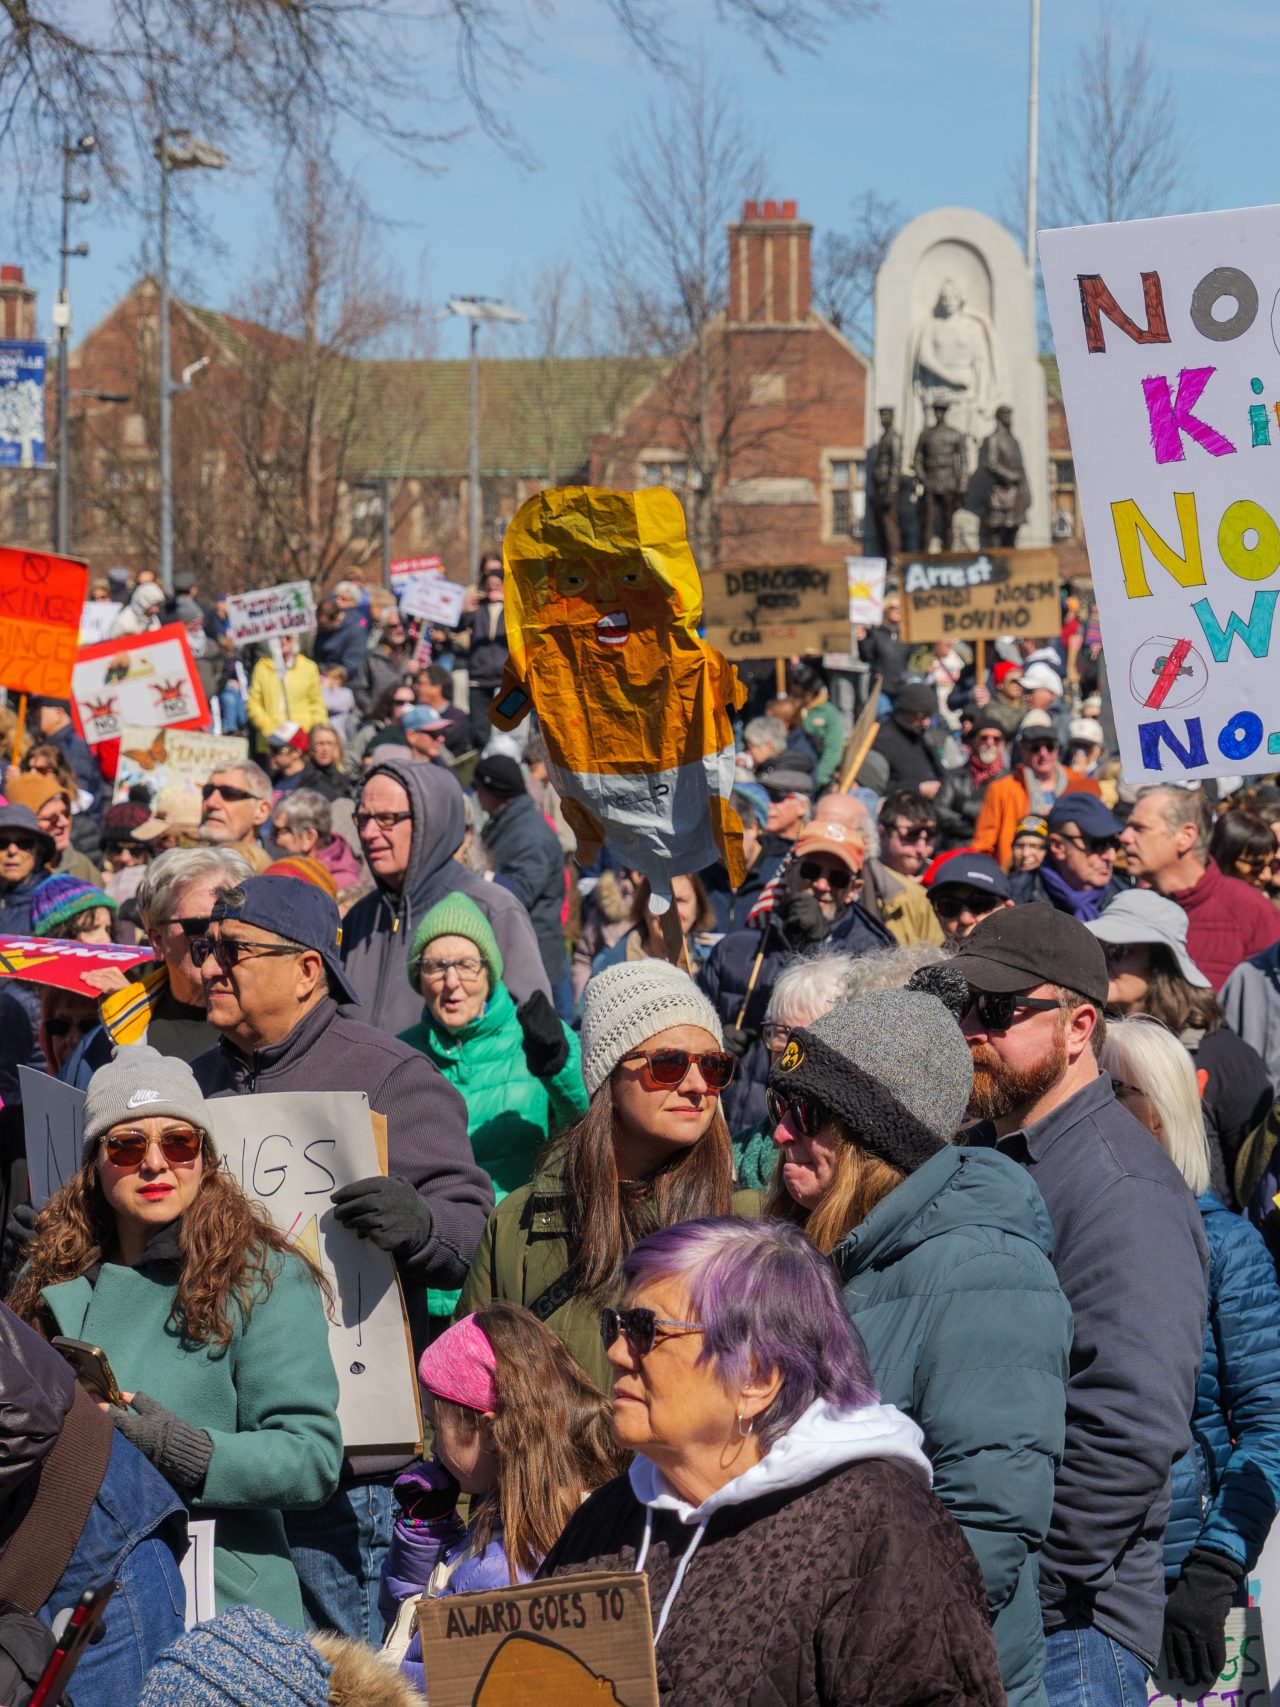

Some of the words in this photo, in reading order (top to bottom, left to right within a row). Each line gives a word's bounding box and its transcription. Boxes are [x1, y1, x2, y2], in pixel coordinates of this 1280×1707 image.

[1076, 266, 1259, 353] NO
[904, 555, 992, 593] Arrest
[943, 607, 1030, 632] BOVINO
[133, 1089, 160, 1101] NIKE
[446, 1601, 522, 1639] AWARD
[528, 1591, 587, 1631] GOES
[597, 1586, 625, 1621] TO
